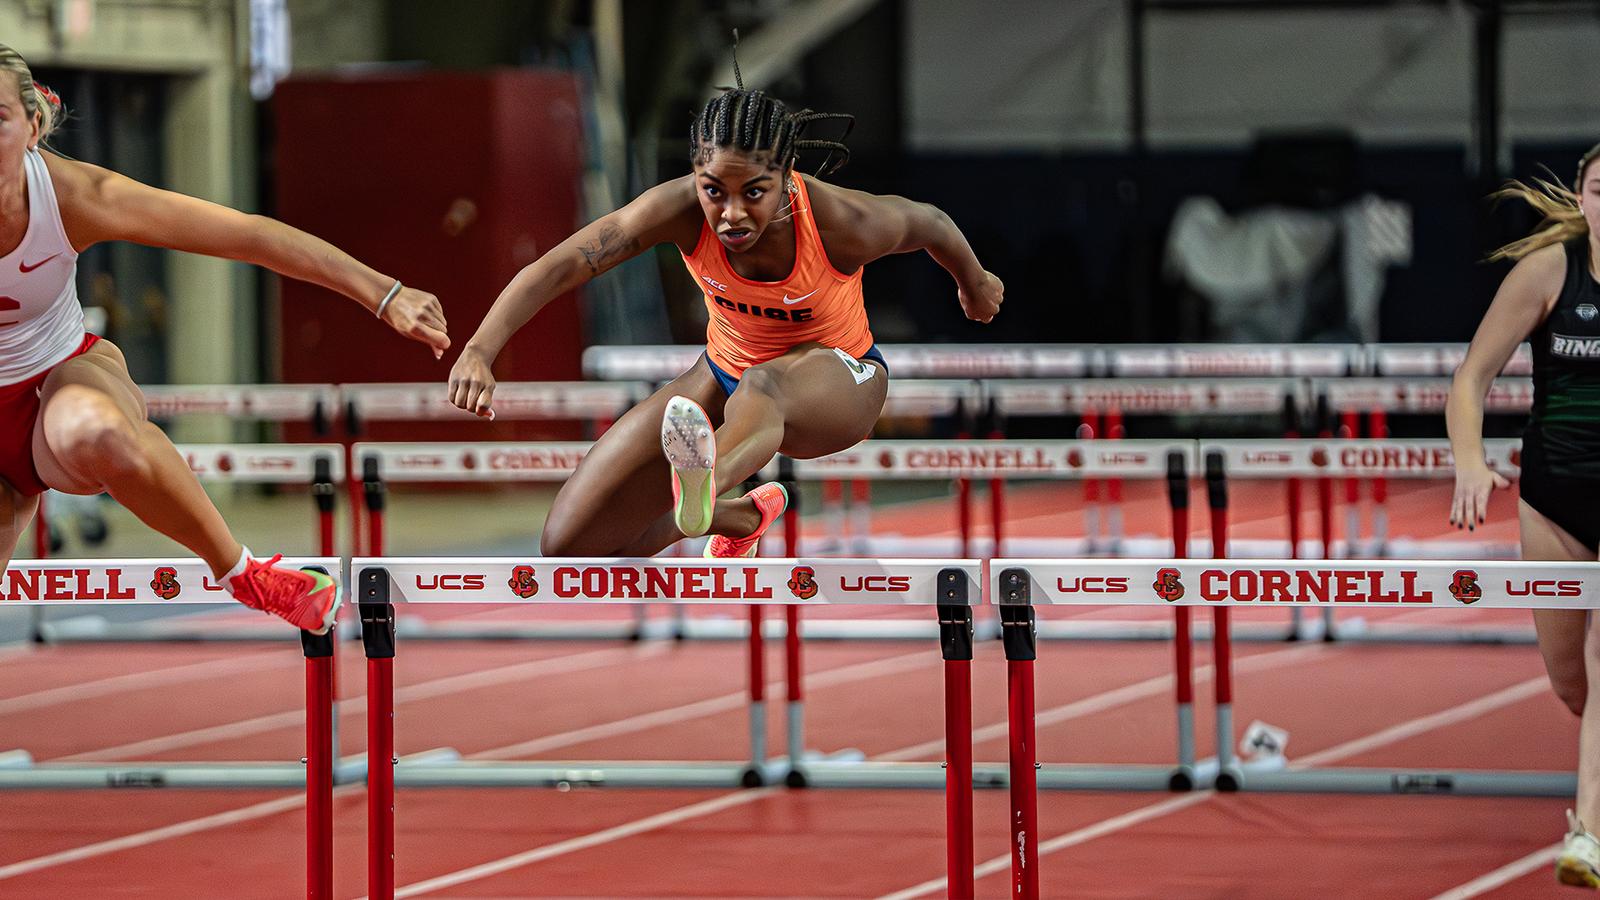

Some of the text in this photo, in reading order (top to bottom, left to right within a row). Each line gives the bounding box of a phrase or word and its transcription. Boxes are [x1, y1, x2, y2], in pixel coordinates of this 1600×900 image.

[702, 275, 727, 292] ACC
[0, 569, 136, 600] NELL
[416, 567, 911, 599] UCS CORNELL UCS
[1057, 570, 1583, 603] UCS CORNELL UCS
